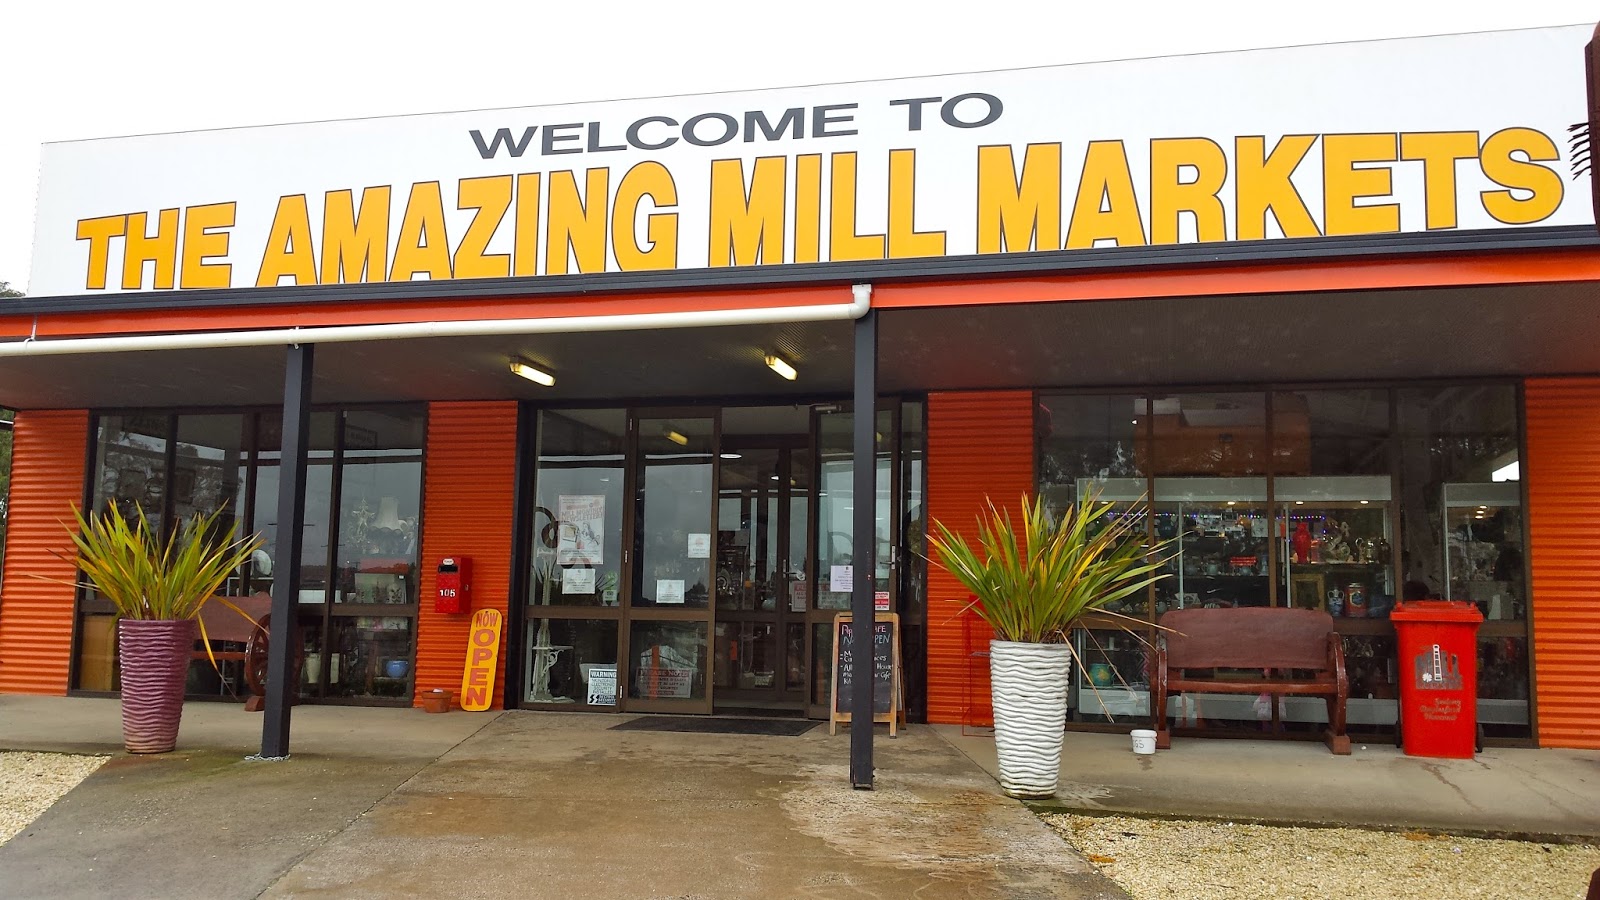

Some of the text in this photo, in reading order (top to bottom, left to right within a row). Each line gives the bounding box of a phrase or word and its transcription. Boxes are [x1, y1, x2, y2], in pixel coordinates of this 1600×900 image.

[469, 92, 1004, 160] WELCOME TO
[76, 127, 1563, 290] THE AMAZING MILL MARKETS
[439, 589, 455, 597] 105
[475, 612, 498, 627] NOW
[465, 628, 496, 706] OPEN
